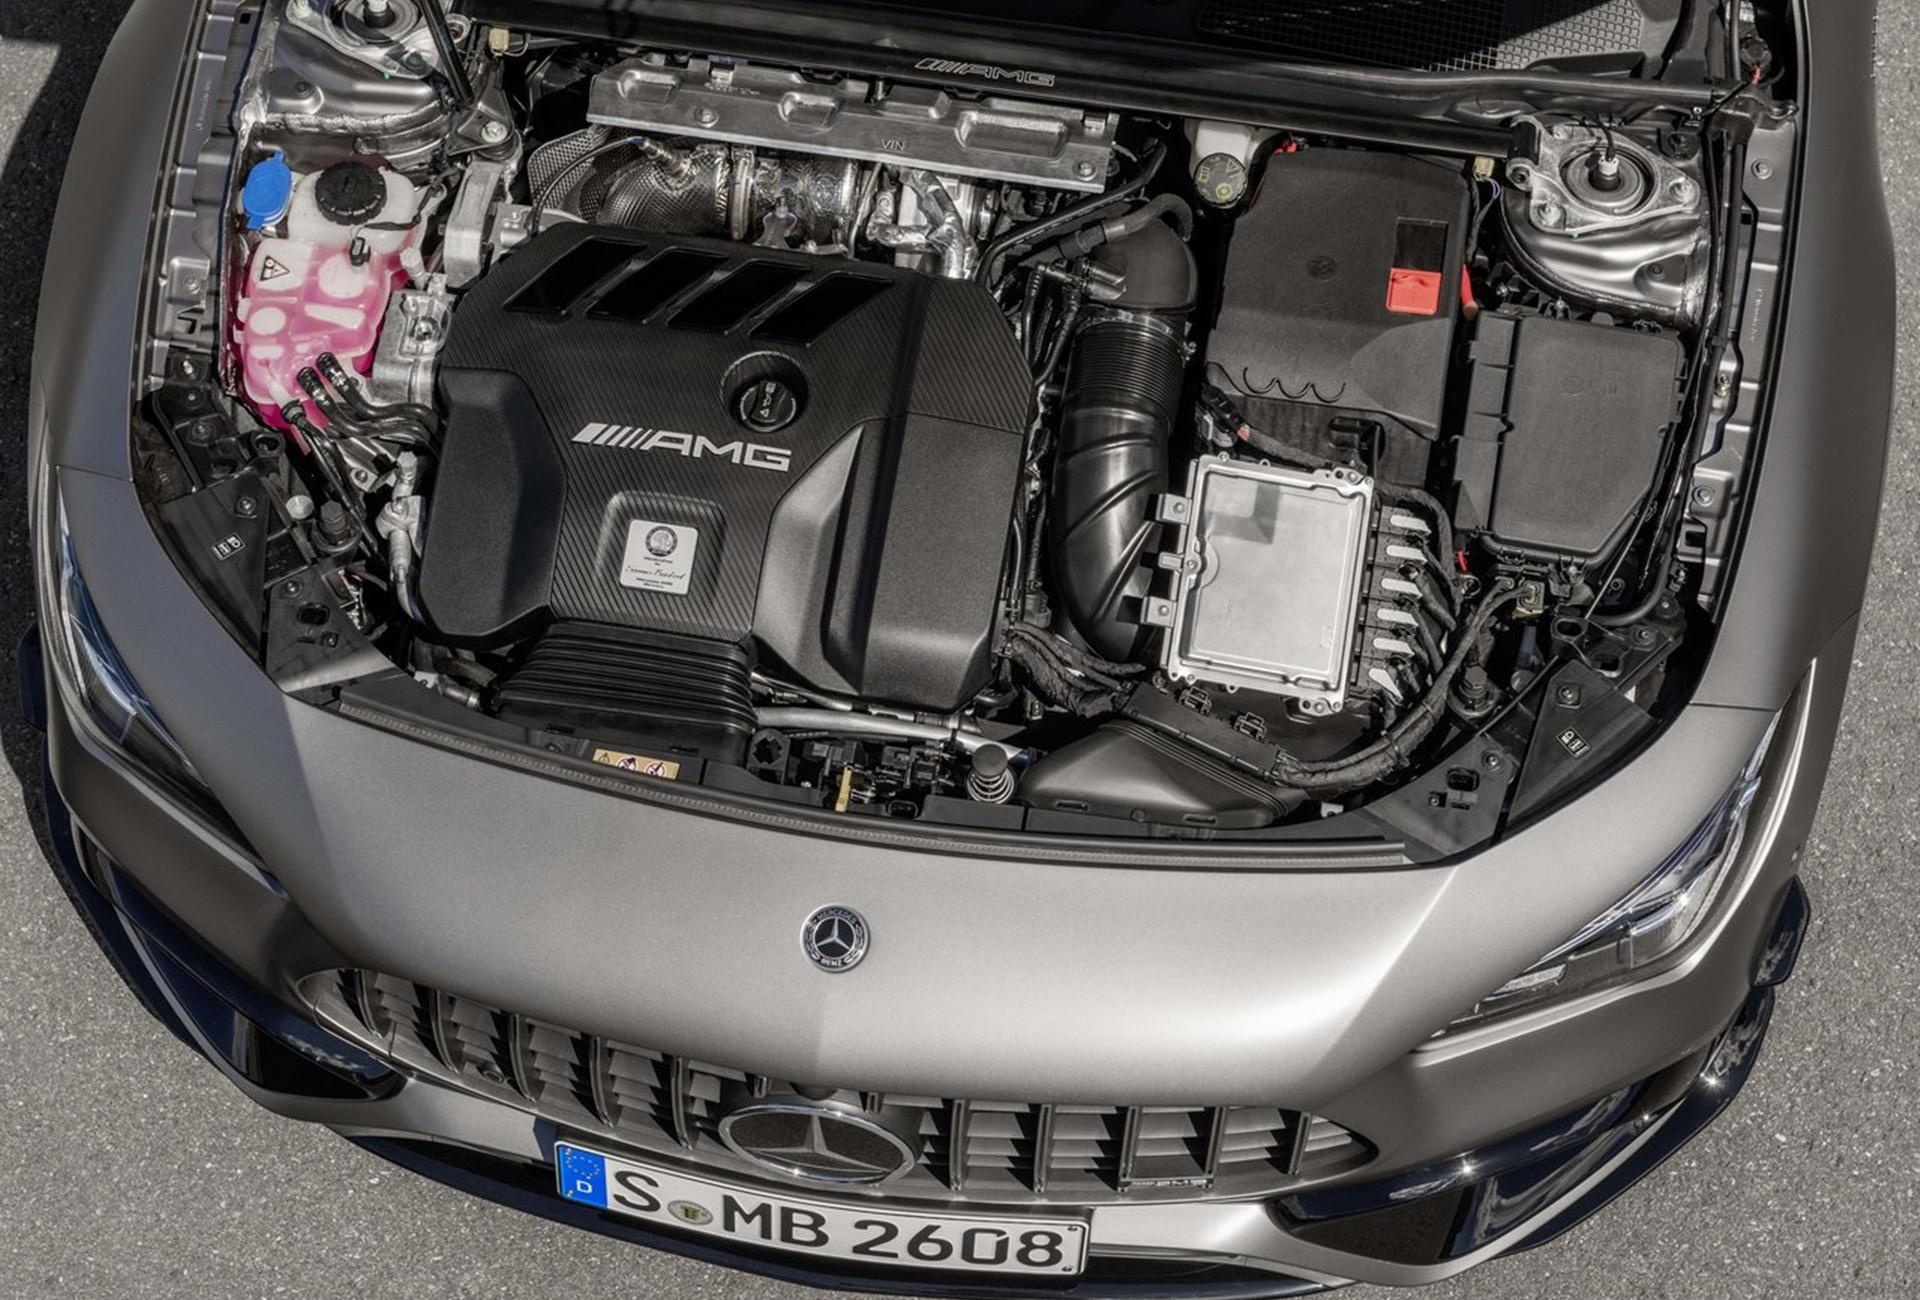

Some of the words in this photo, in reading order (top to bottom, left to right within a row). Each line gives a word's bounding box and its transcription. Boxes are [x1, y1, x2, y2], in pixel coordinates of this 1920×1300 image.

[961, 62, 1056, 88] AMG
[639, 429, 793, 472] AMG
[576, 1179, 593, 1194] D
[612, 1170, 662, 1213] S
[722, 1194, 830, 1249] MB
[852, 1219, 1064, 1268] 2608
